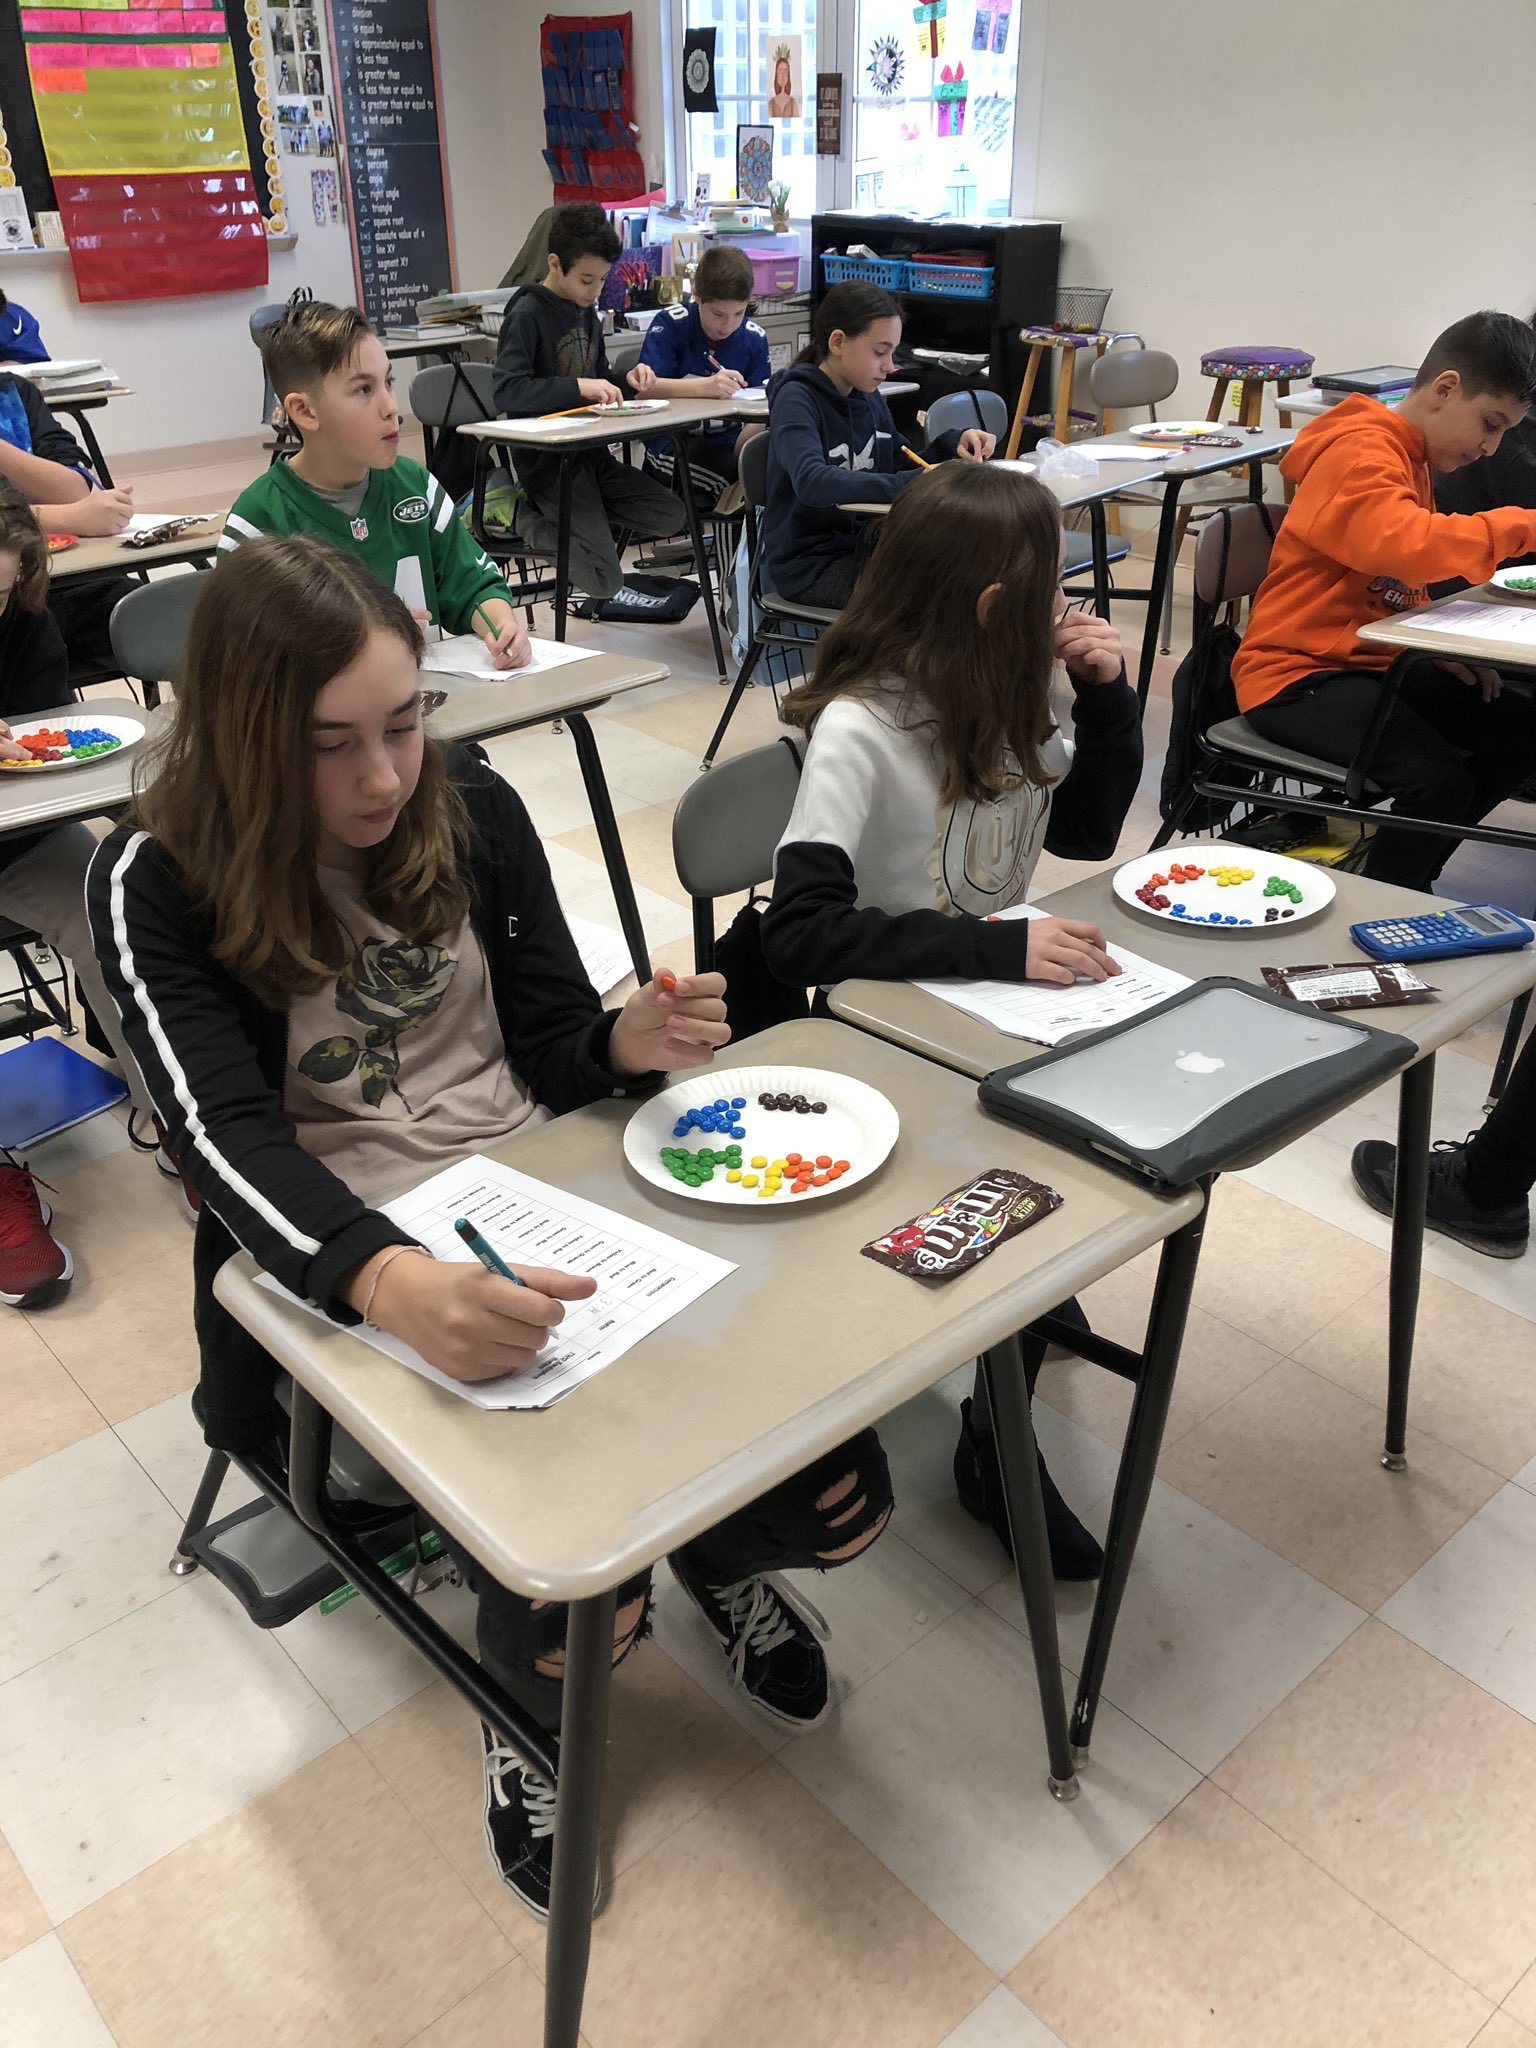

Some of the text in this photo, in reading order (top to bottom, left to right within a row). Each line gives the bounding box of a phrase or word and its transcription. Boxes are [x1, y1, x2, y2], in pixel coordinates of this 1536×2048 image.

[353, 23, 383, 36] is equal to
[354, 38, 424, 53] is approximately equal to
[356, 53, 389, 65] is less than
[358, 69, 400, 82] is greater than
[359, 83, 423, 97] is less than or equal to
[361, 99, 366, 110] is
[368, 100, 388, 112] greater
[390, 100, 403, 110] than
[412, 100, 426, 112] equal
[427, 101, 433, 109] to
[362, 114, 402, 127] is not equal to
[366, 147, 385, 159] degree
[367, 160, 388, 172] percent
[369, 174, 383, 187] angle
[370, 187, 400, 202] right angle
[372, 203, 393, 215] triangle
[373, 216, 404, 230] square root
[375, 229, 397, 241] absolute
[398, 231, 412, 240] value
[413, 227, 419, 239] of
[376, 244, 395, 254] line XY
[377, 259, 399, 271] segment
[400, 257, 409, 267] XY
[379, 271, 398, 284] ray XY
[381, 284, 429, 298] is perpendicular to
[381, 299, 415, 310] is parallel to
[383, 311, 402, 324] infinity
[399, 505, 425, 516] JETS
[468, 1186, 486, 1197] Orange
[447, 1199, 463, 1209] Yellow
[486, 1194, 501, 1204] Brown
[464, 1206, 481, 1216] Yellow
[505, 1202, 517, 1210] Blue
[1011, 1197, 1031, 1217] CHOCOLATE
[1017, 1200, 1036, 1219] MILK
[482, 1212, 500, 1223] Orange
[515, 1210, 533, 1222] Orange
[518, 1228, 534, 1239] Yellow
[552, 1227, 567, 1236] Green
[567, 1235, 584, 1245] Yellow
[589, 1240, 604, 1250] Green
[552, 1247, 563, 1255] Red
[606, 1249, 622, 1260] Yellow
[566, 1252, 585, 1264] Orange
[624, 1260, 636, 1268] Blue
[585, 1262, 602, 1273] Brown
[646, 1268, 657, 1276] Red
[609, 1271, 620, 1279] Red
[627, 1278, 642, 1288] Green
[559, 1351, 576, 1362] TWO
